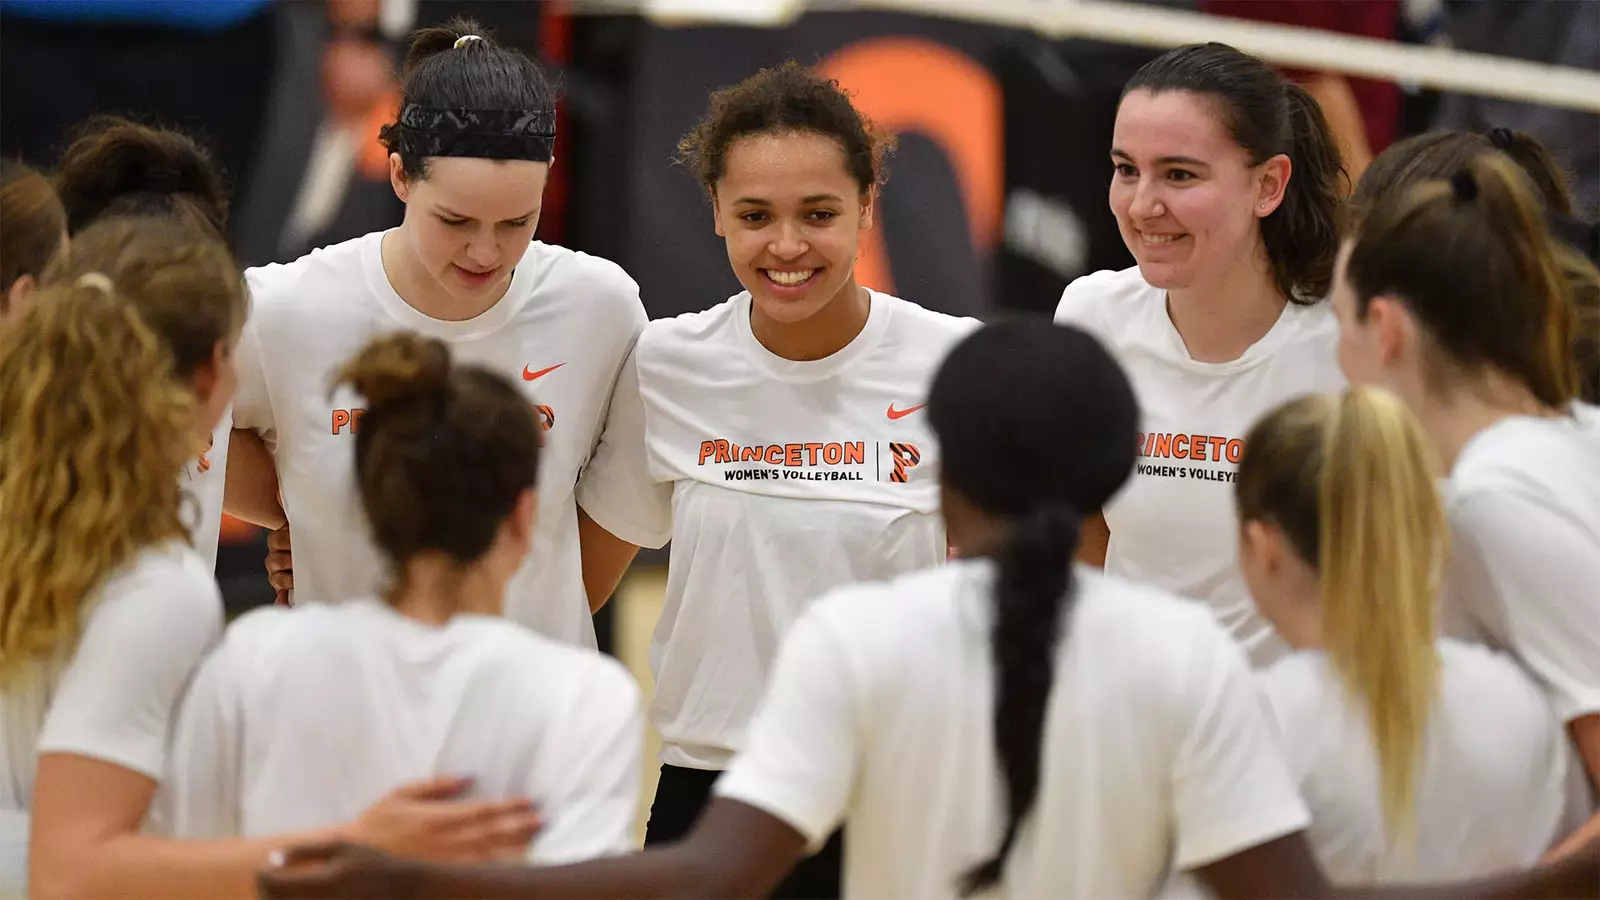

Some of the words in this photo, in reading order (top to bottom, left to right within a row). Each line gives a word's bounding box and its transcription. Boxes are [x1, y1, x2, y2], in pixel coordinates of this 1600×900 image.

[698, 439, 865, 467] PRINCETON
[1135, 431, 1246, 464] RINCETO
[724, 469, 779, 481] WOMEN'S
[783, 470, 863, 481] VOLLEYBALL
[1137, 464, 1186, 478] WOMEN'S
[1189, 467, 1240, 483] VOLLEY
